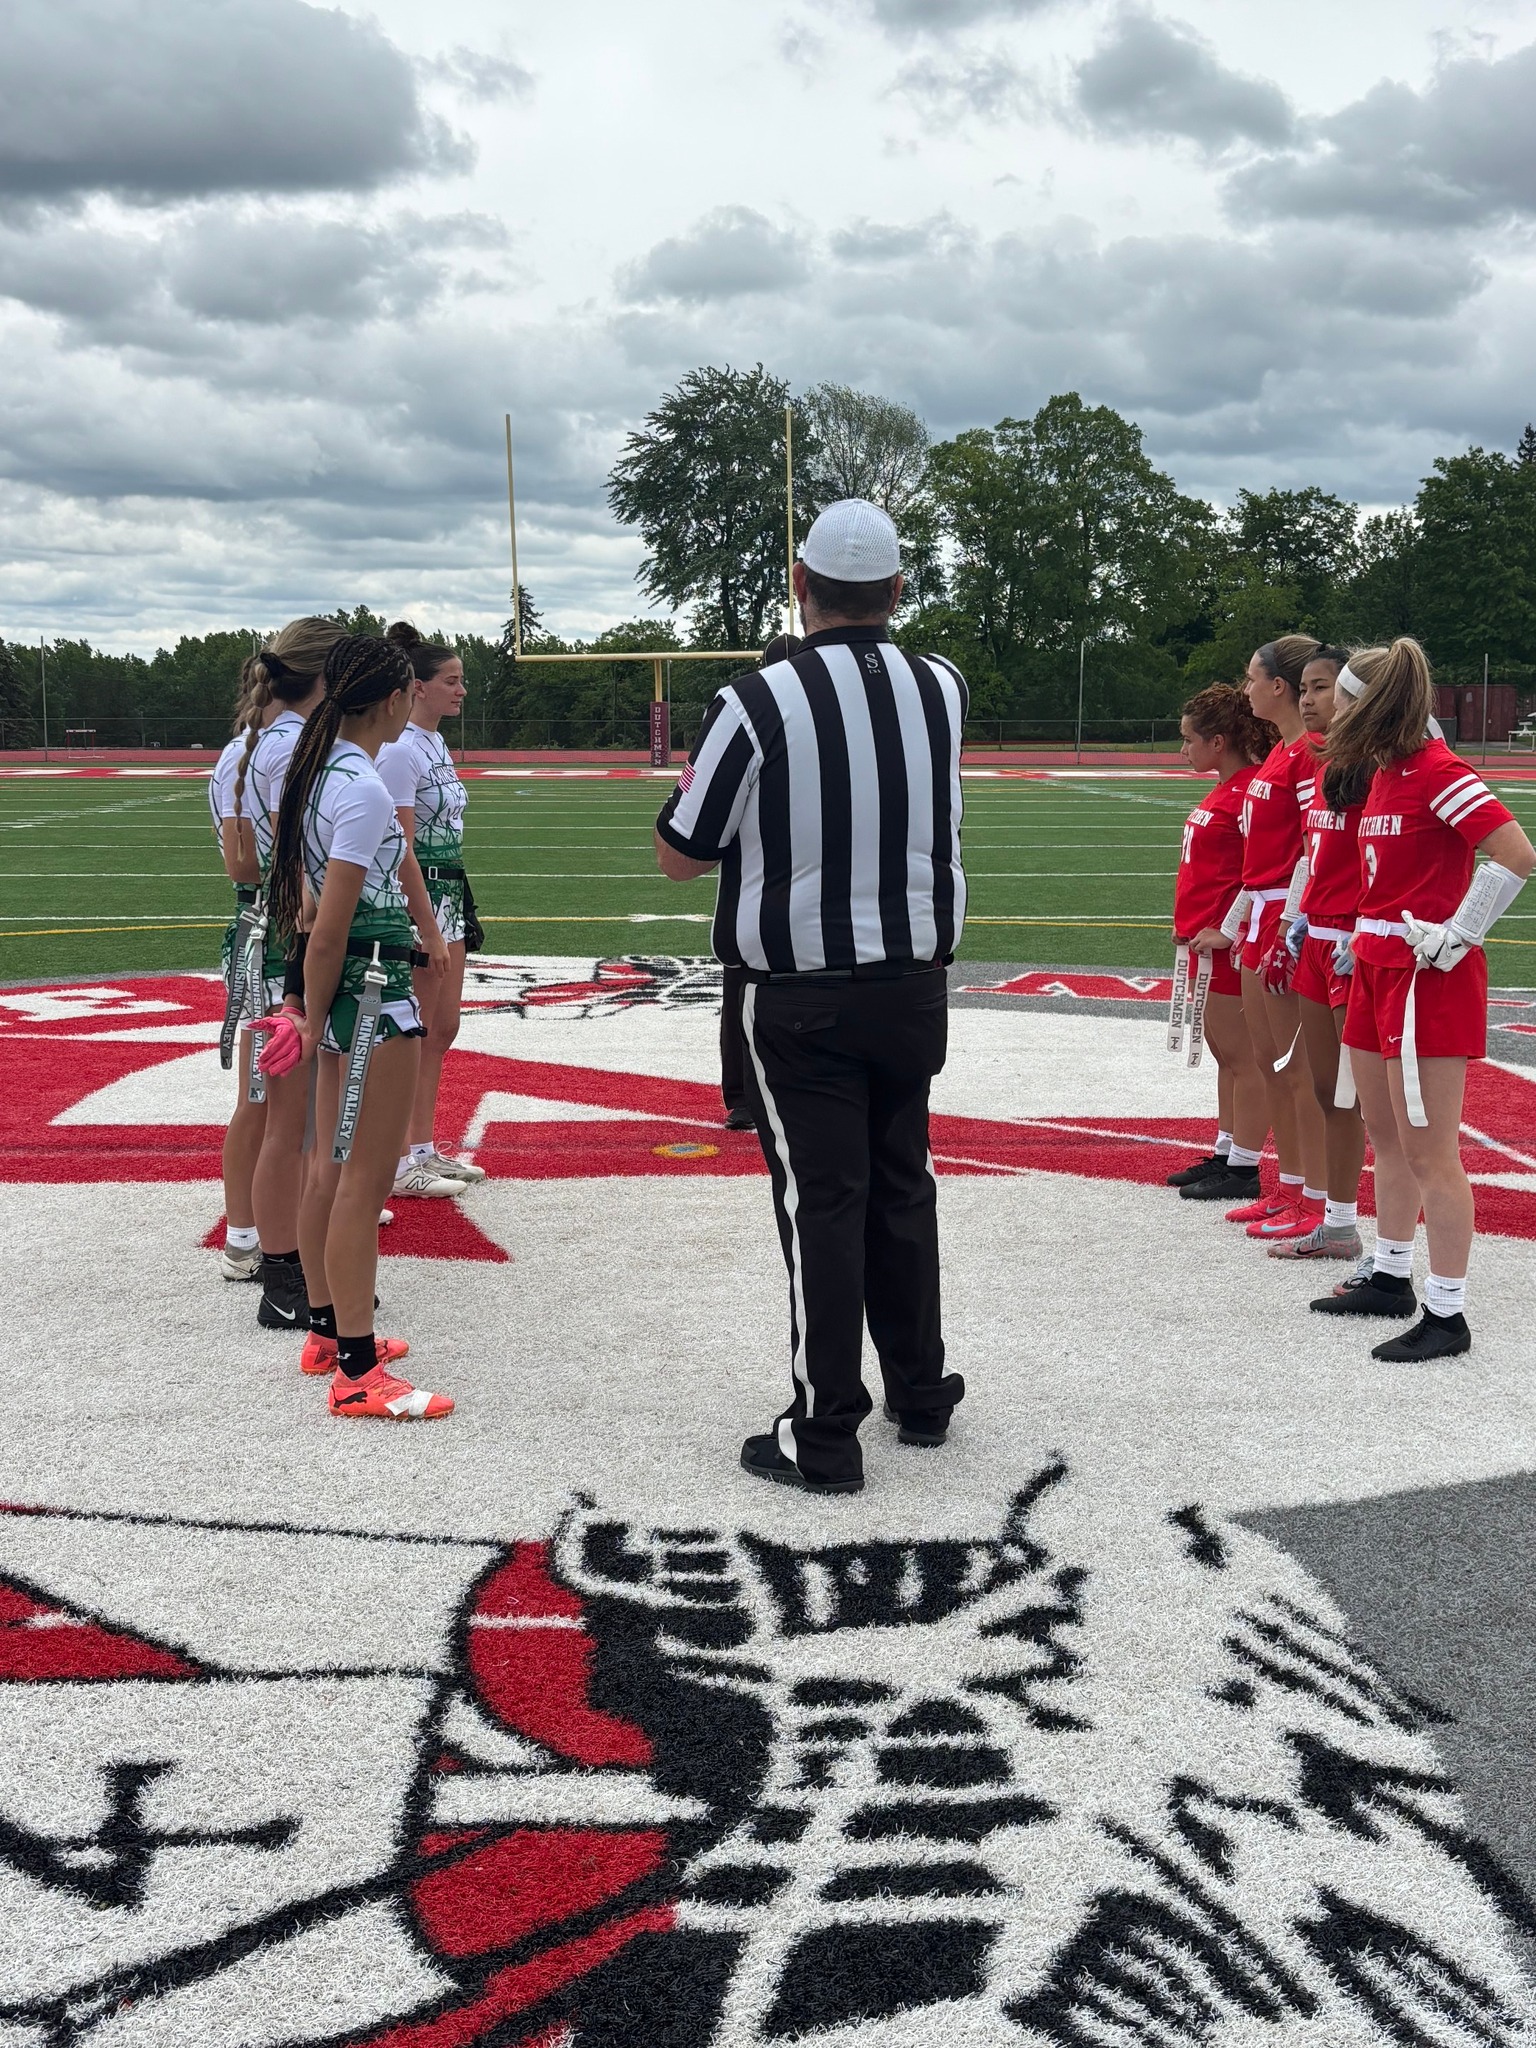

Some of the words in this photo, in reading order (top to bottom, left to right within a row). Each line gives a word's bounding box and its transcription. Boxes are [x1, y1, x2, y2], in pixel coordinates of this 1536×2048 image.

[653, 706, 662, 765] DUTCHMEN
[1310, 832, 1322, 877] 7
[232, 946, 246, 1001] MINISINK
[252, 968, 263, 1019] MINISIN
[1171, 959, 1188, 1029] DUTCHMEN
[222, 1005, 240, 1050] VALLEY
[1192, 973, 1209, 1044] DUTCHMEN
[349, 1014, 375, 1081] MINISINK
[339, 1083, 361, 1140] VALLEY
